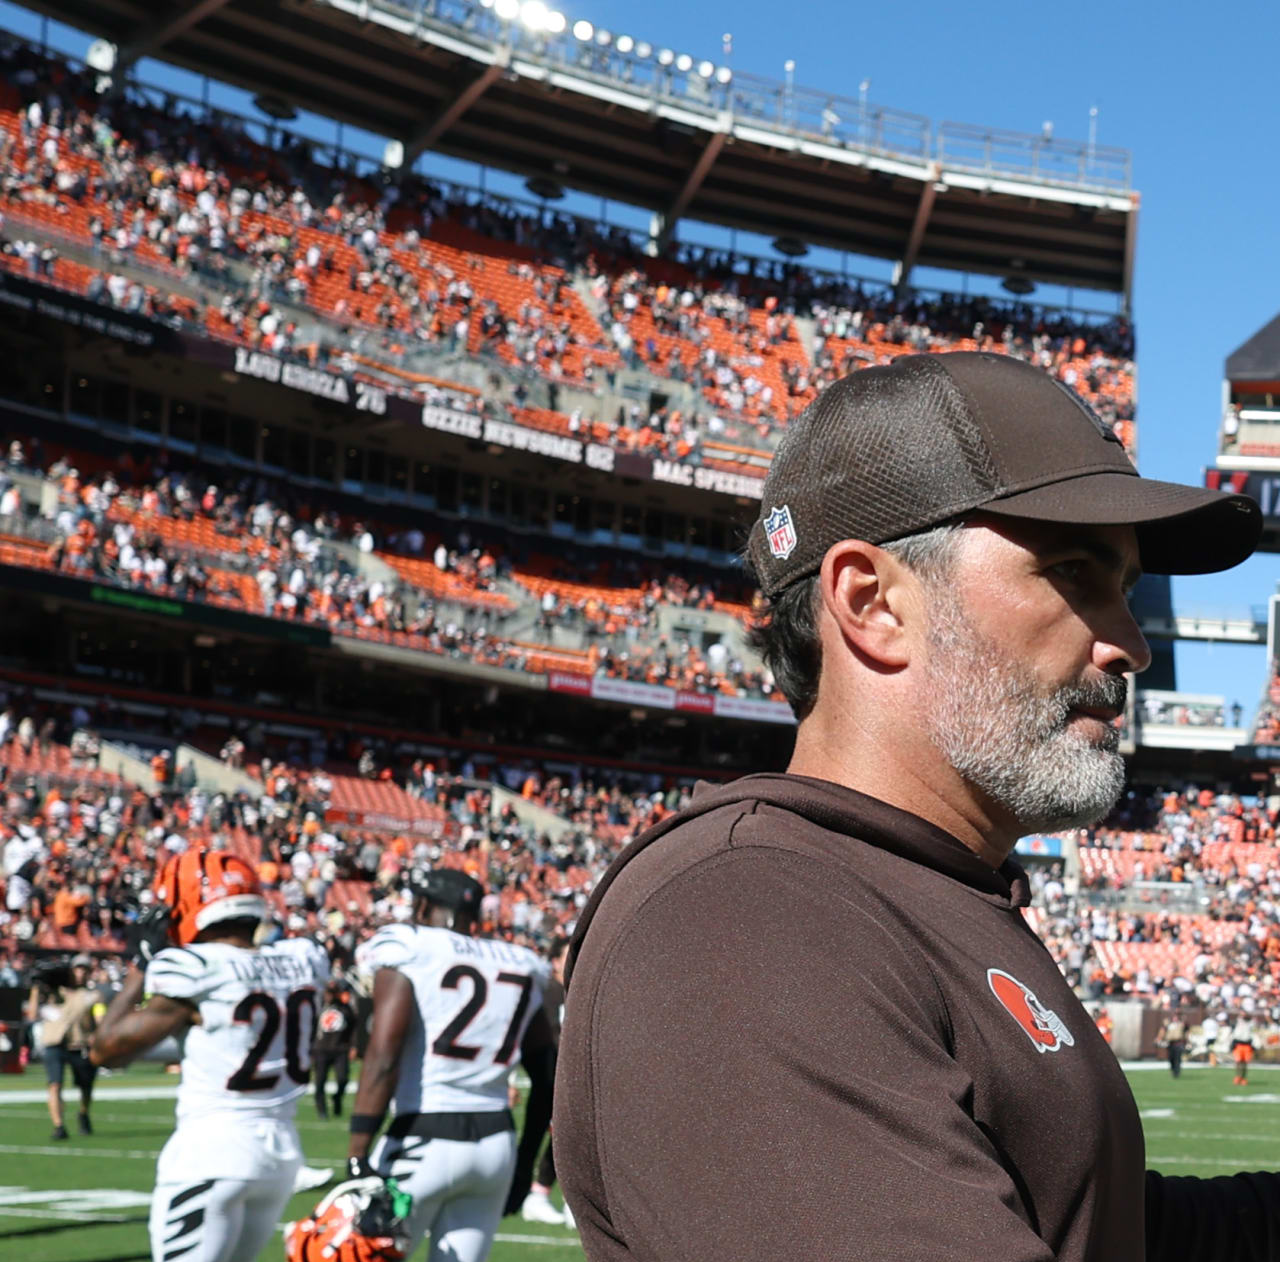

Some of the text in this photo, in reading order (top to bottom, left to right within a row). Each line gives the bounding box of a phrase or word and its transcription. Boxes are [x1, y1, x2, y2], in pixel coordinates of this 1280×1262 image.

[770, 527, 793, 553] NFL
[226, 985, 317, 1093] 20
[431, 962, 534, 1067] 27
